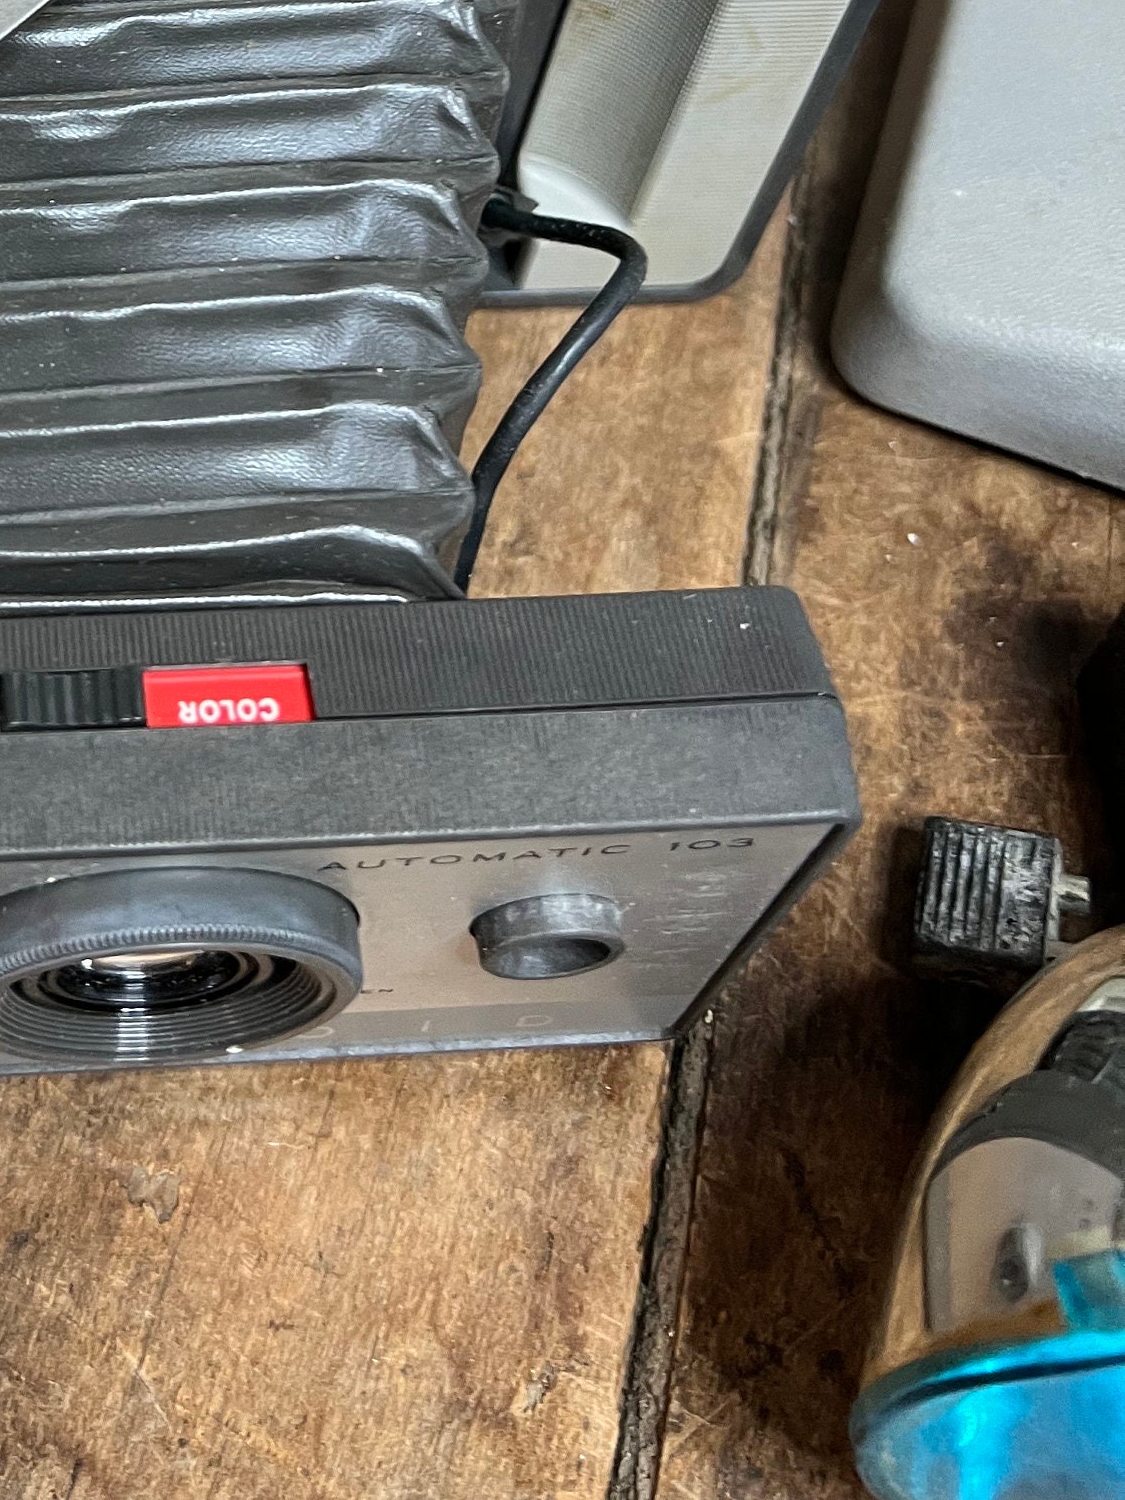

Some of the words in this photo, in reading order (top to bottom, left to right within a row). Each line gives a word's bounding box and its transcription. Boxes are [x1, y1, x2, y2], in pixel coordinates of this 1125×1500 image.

[177, 696, 280, 722] COLOR
[316, 842, 631, 873] AUTOMATIC
[669, 836, 755, 853] 103
